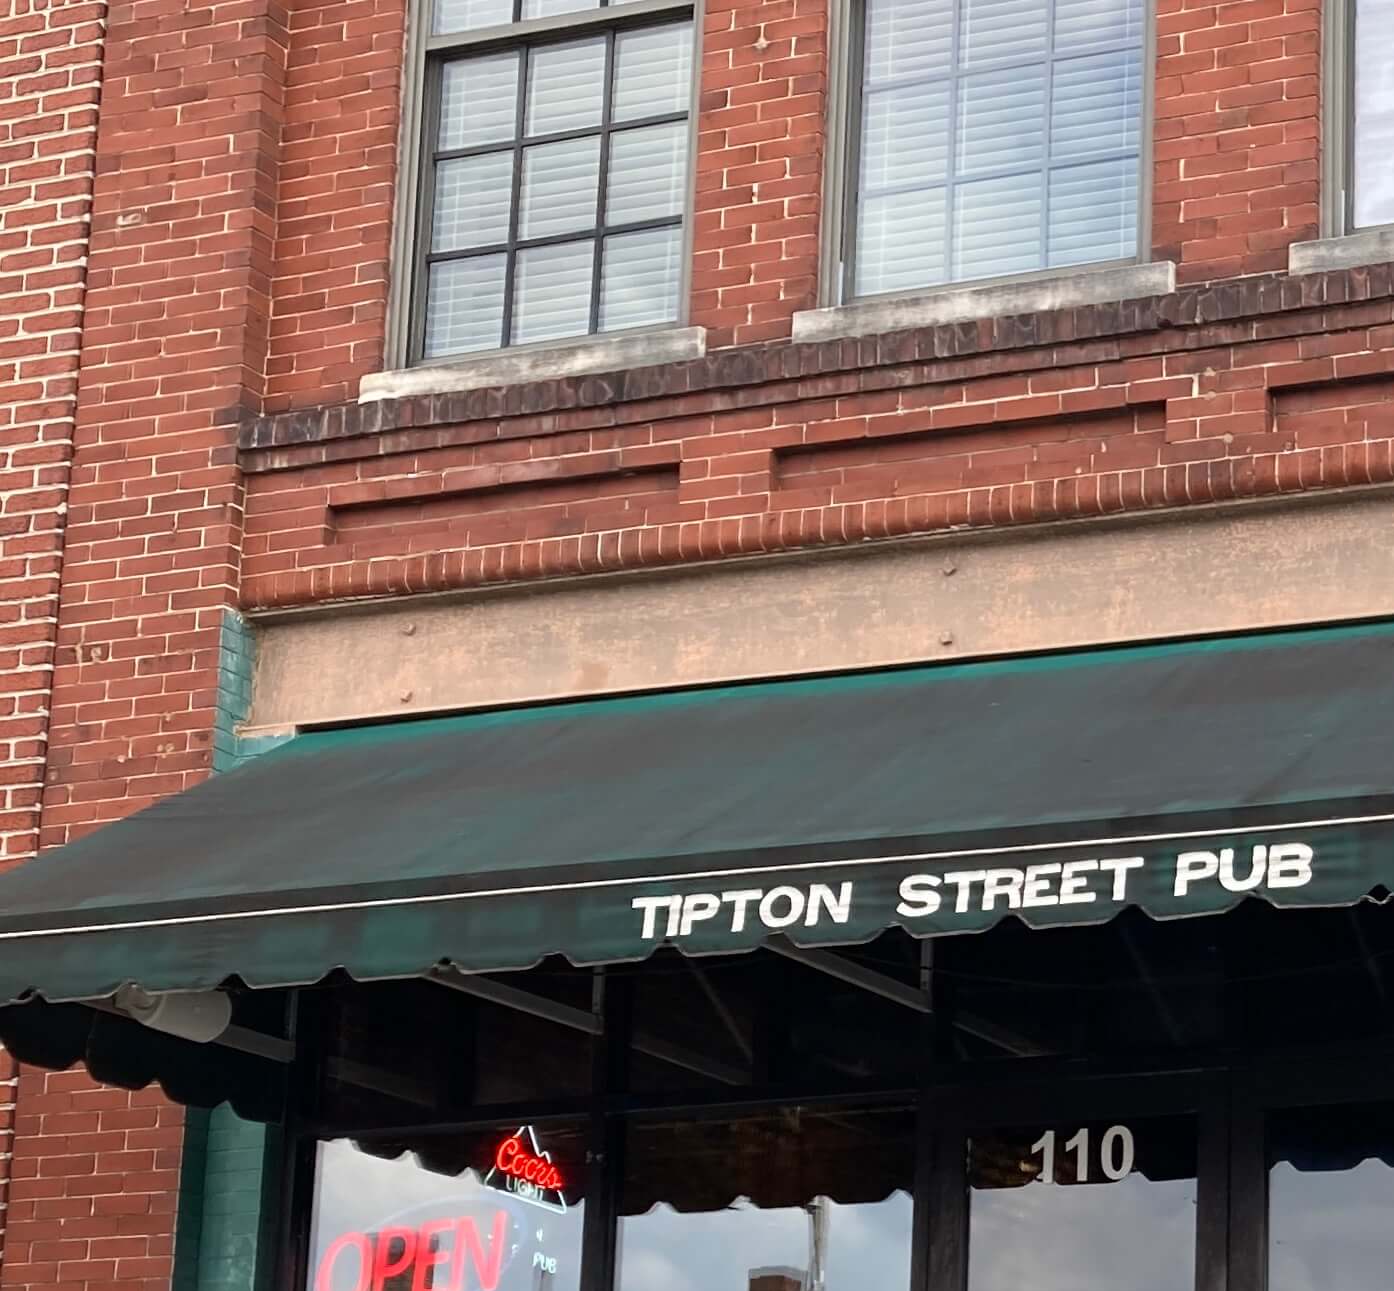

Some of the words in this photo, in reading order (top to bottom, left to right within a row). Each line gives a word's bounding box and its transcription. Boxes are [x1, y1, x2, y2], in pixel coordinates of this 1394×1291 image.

[632, 881, 853, 940] TIPTON
[896, 857, 1145, 917] STREET
[1173, 842, 1314, 897] PUB
[496, 1137, 562, 1189] Coors
[1031, 1124, 1134, 1184] 110
[505, 1174, 546, 1201] LIGHT
